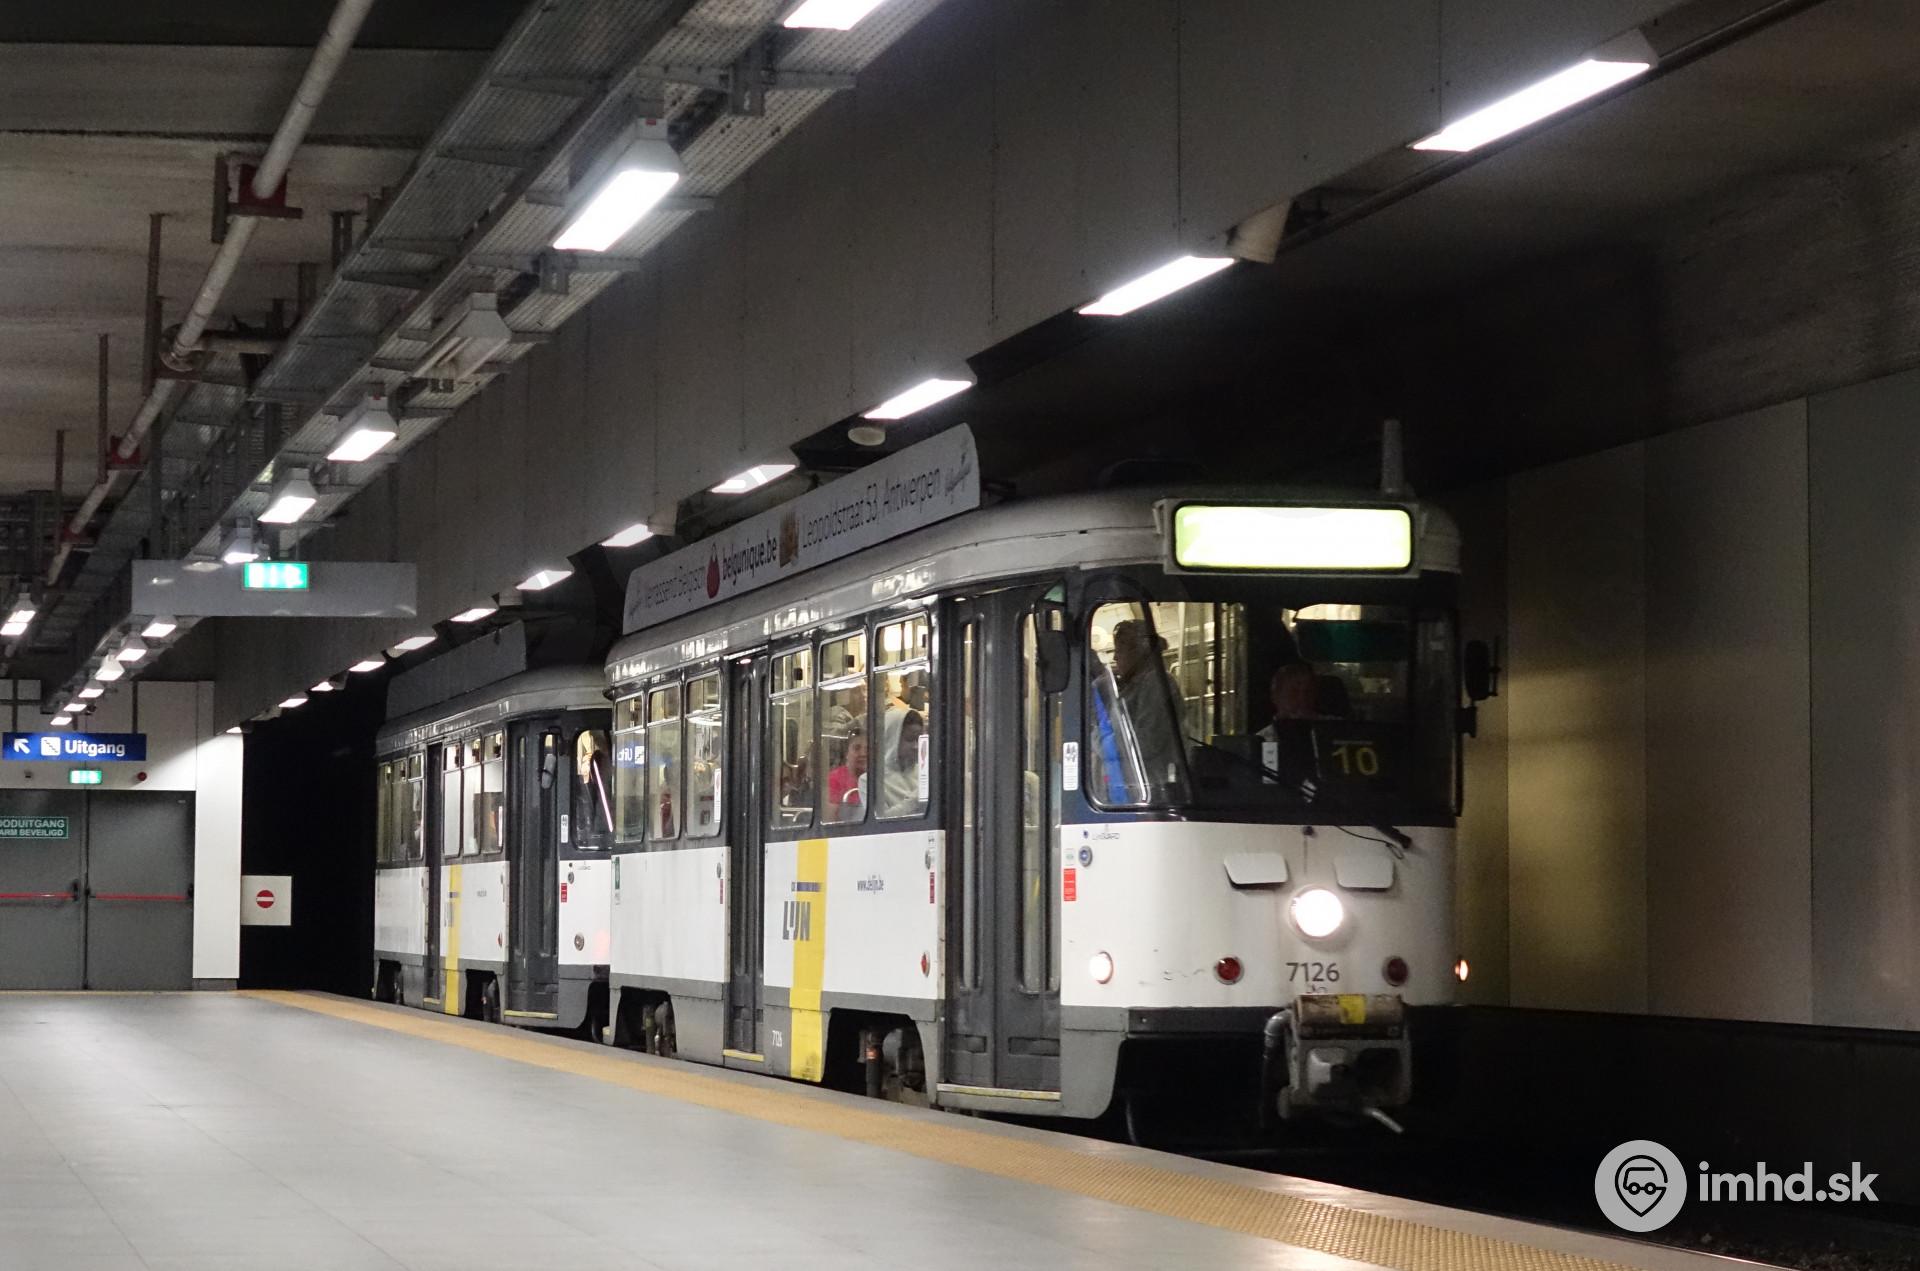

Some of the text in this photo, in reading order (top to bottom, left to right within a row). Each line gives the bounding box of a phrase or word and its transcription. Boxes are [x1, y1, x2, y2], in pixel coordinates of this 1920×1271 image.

[801, 496, 864, 552] Leopoldstraat
[882, 468, 941, 516] Antwerpen
[64, 739, 126, 757] Uitgang
[1332, 746, 1379, 776] 10
[1286, 962, 1340, 982] 7126
